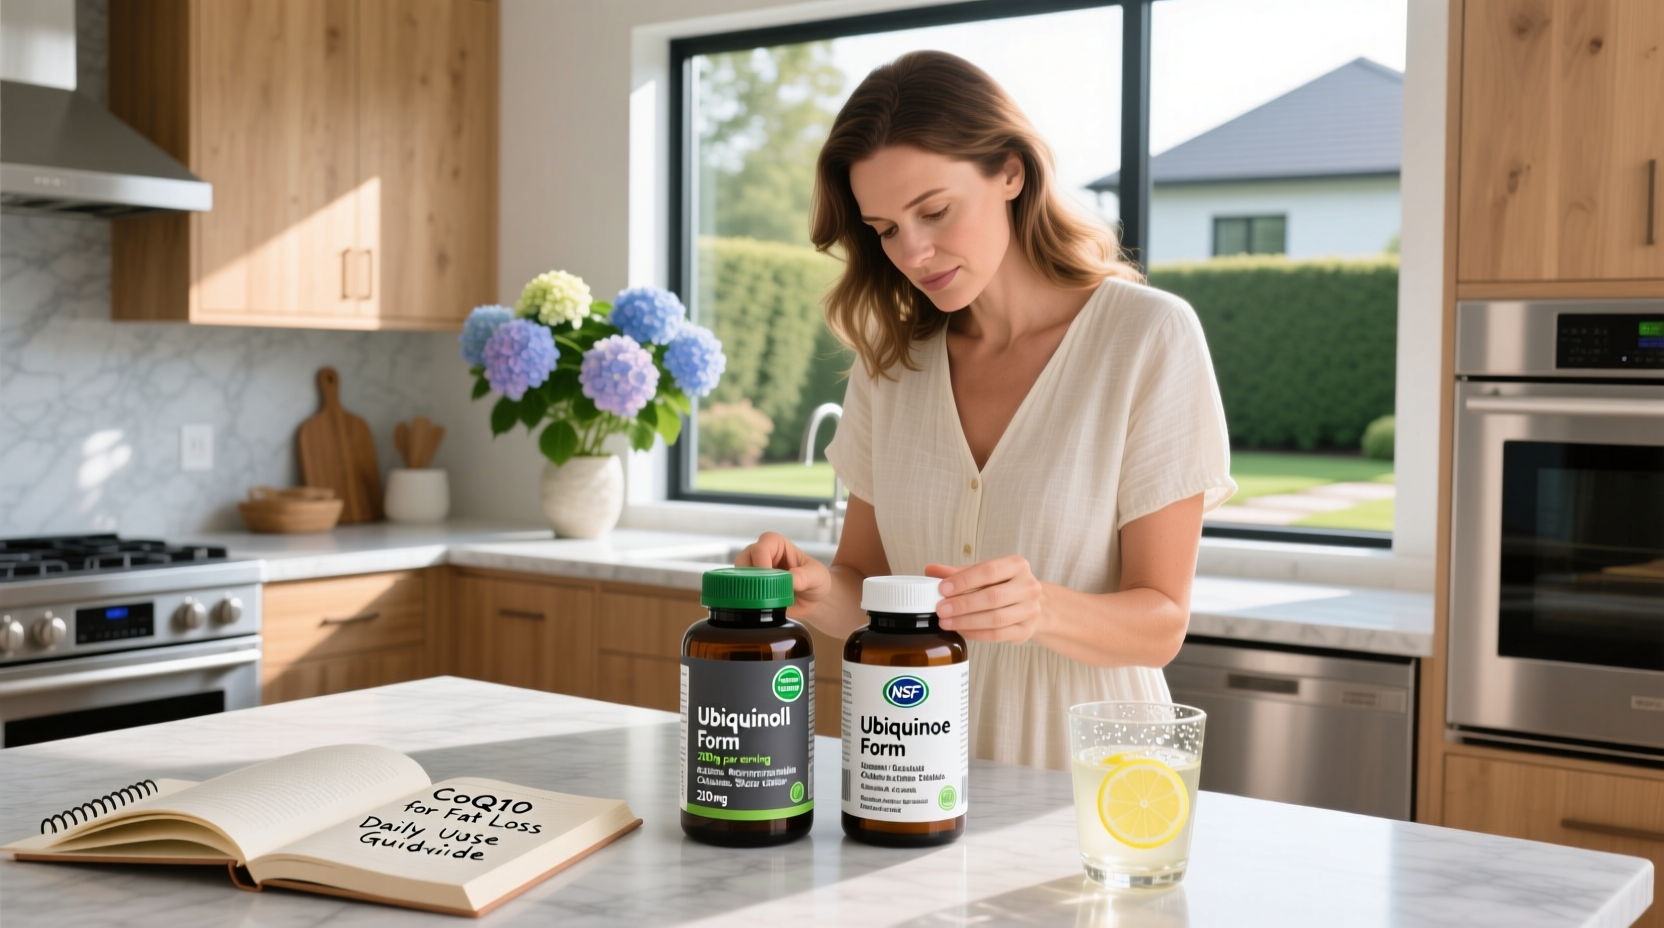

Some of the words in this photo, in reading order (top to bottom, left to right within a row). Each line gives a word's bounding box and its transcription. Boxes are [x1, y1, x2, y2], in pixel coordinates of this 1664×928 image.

[892, 685, 921, 699] NSF
[698, 706, 790, 734] Ubiquinoll
[860, 715, 951, 741] Ubiquinoe
[698, 729, 740, 750] Form
[860, 737, 906, 757] Form
[433, 788, 533, 814] CoQ10
[359, 816, 426, 840] Daily
[404, 800, 439, 815] for
[443, 807, 483, 824] Fat
[488, 813, 542, 834] Loss
